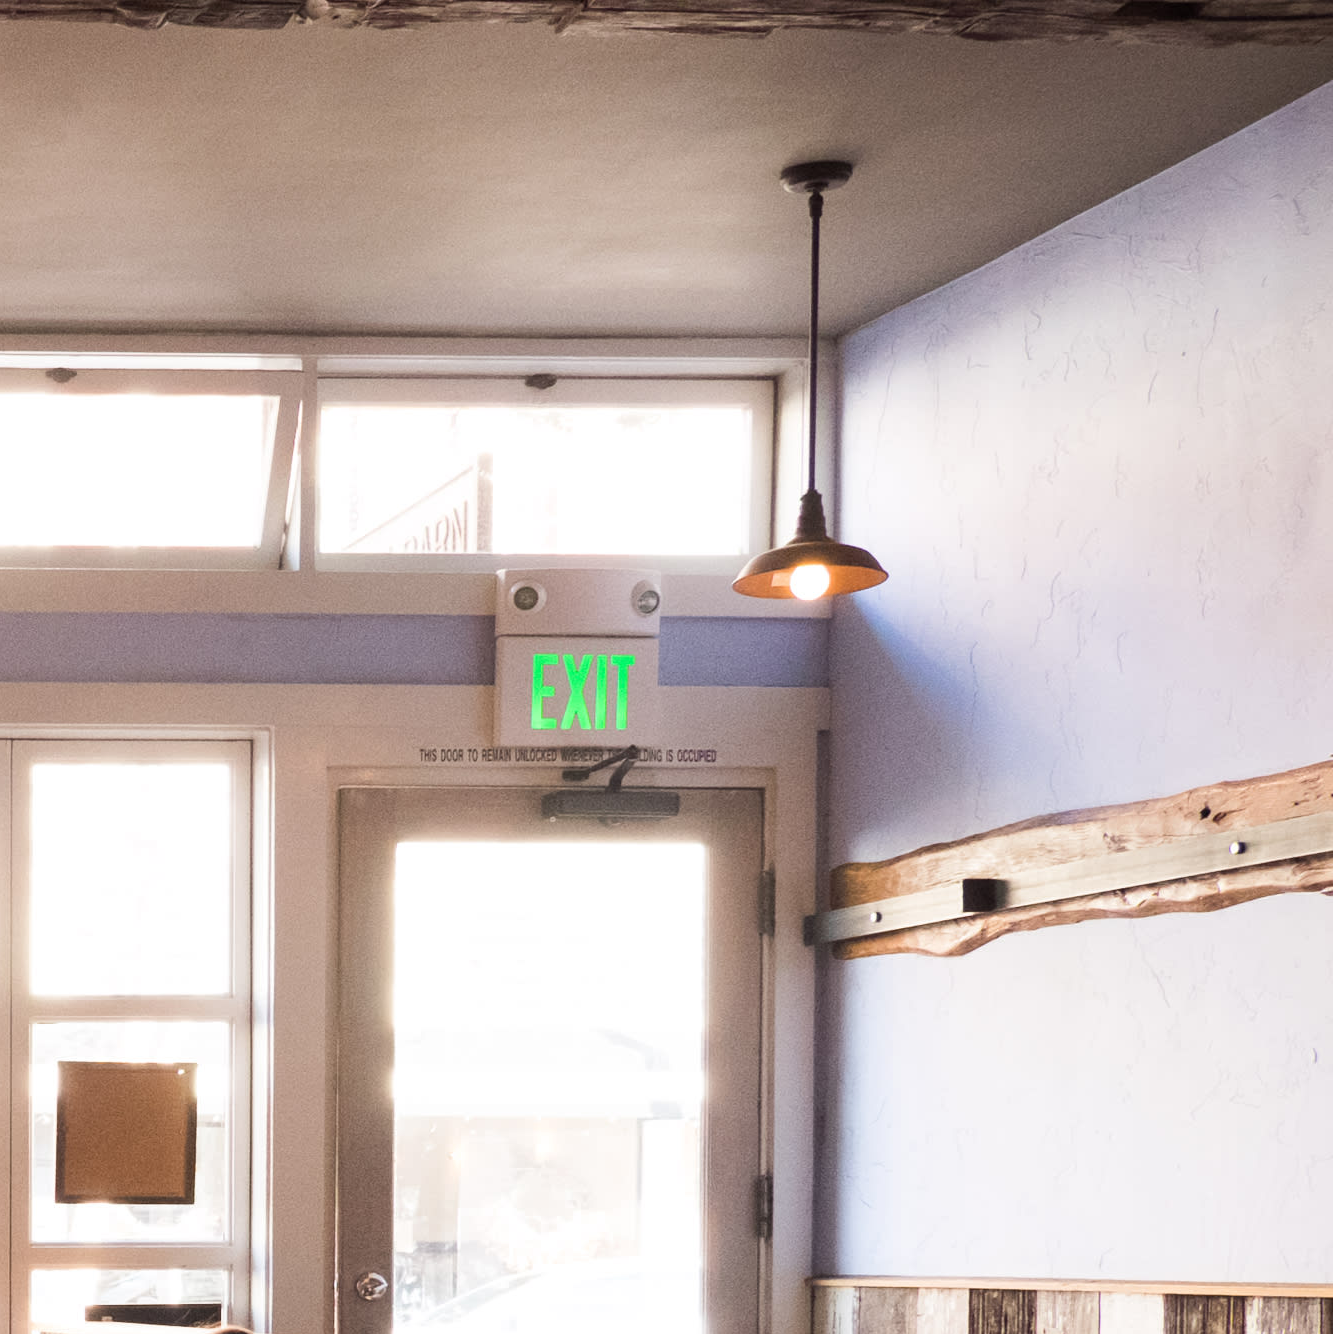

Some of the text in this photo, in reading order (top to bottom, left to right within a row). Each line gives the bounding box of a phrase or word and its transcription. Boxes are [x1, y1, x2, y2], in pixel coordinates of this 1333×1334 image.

[404, 500, 468, 550] ARN
[530, 653, 636, 730] EXIT
[419, 748, 437, 762] THIS
[440, 748, 464, 762] DOOR
[467, 748, 479, 762] TO
[481, 748, 512, 762] REMAIN
[514, 748, 558, 762] UNLOCKED
[561, 748, 604, 762] WHENEVER
[632, 749, 663, 763] LDING
[665, 749, 674, 763] IS
[677, 749, 718, 763] OCCUPIED
